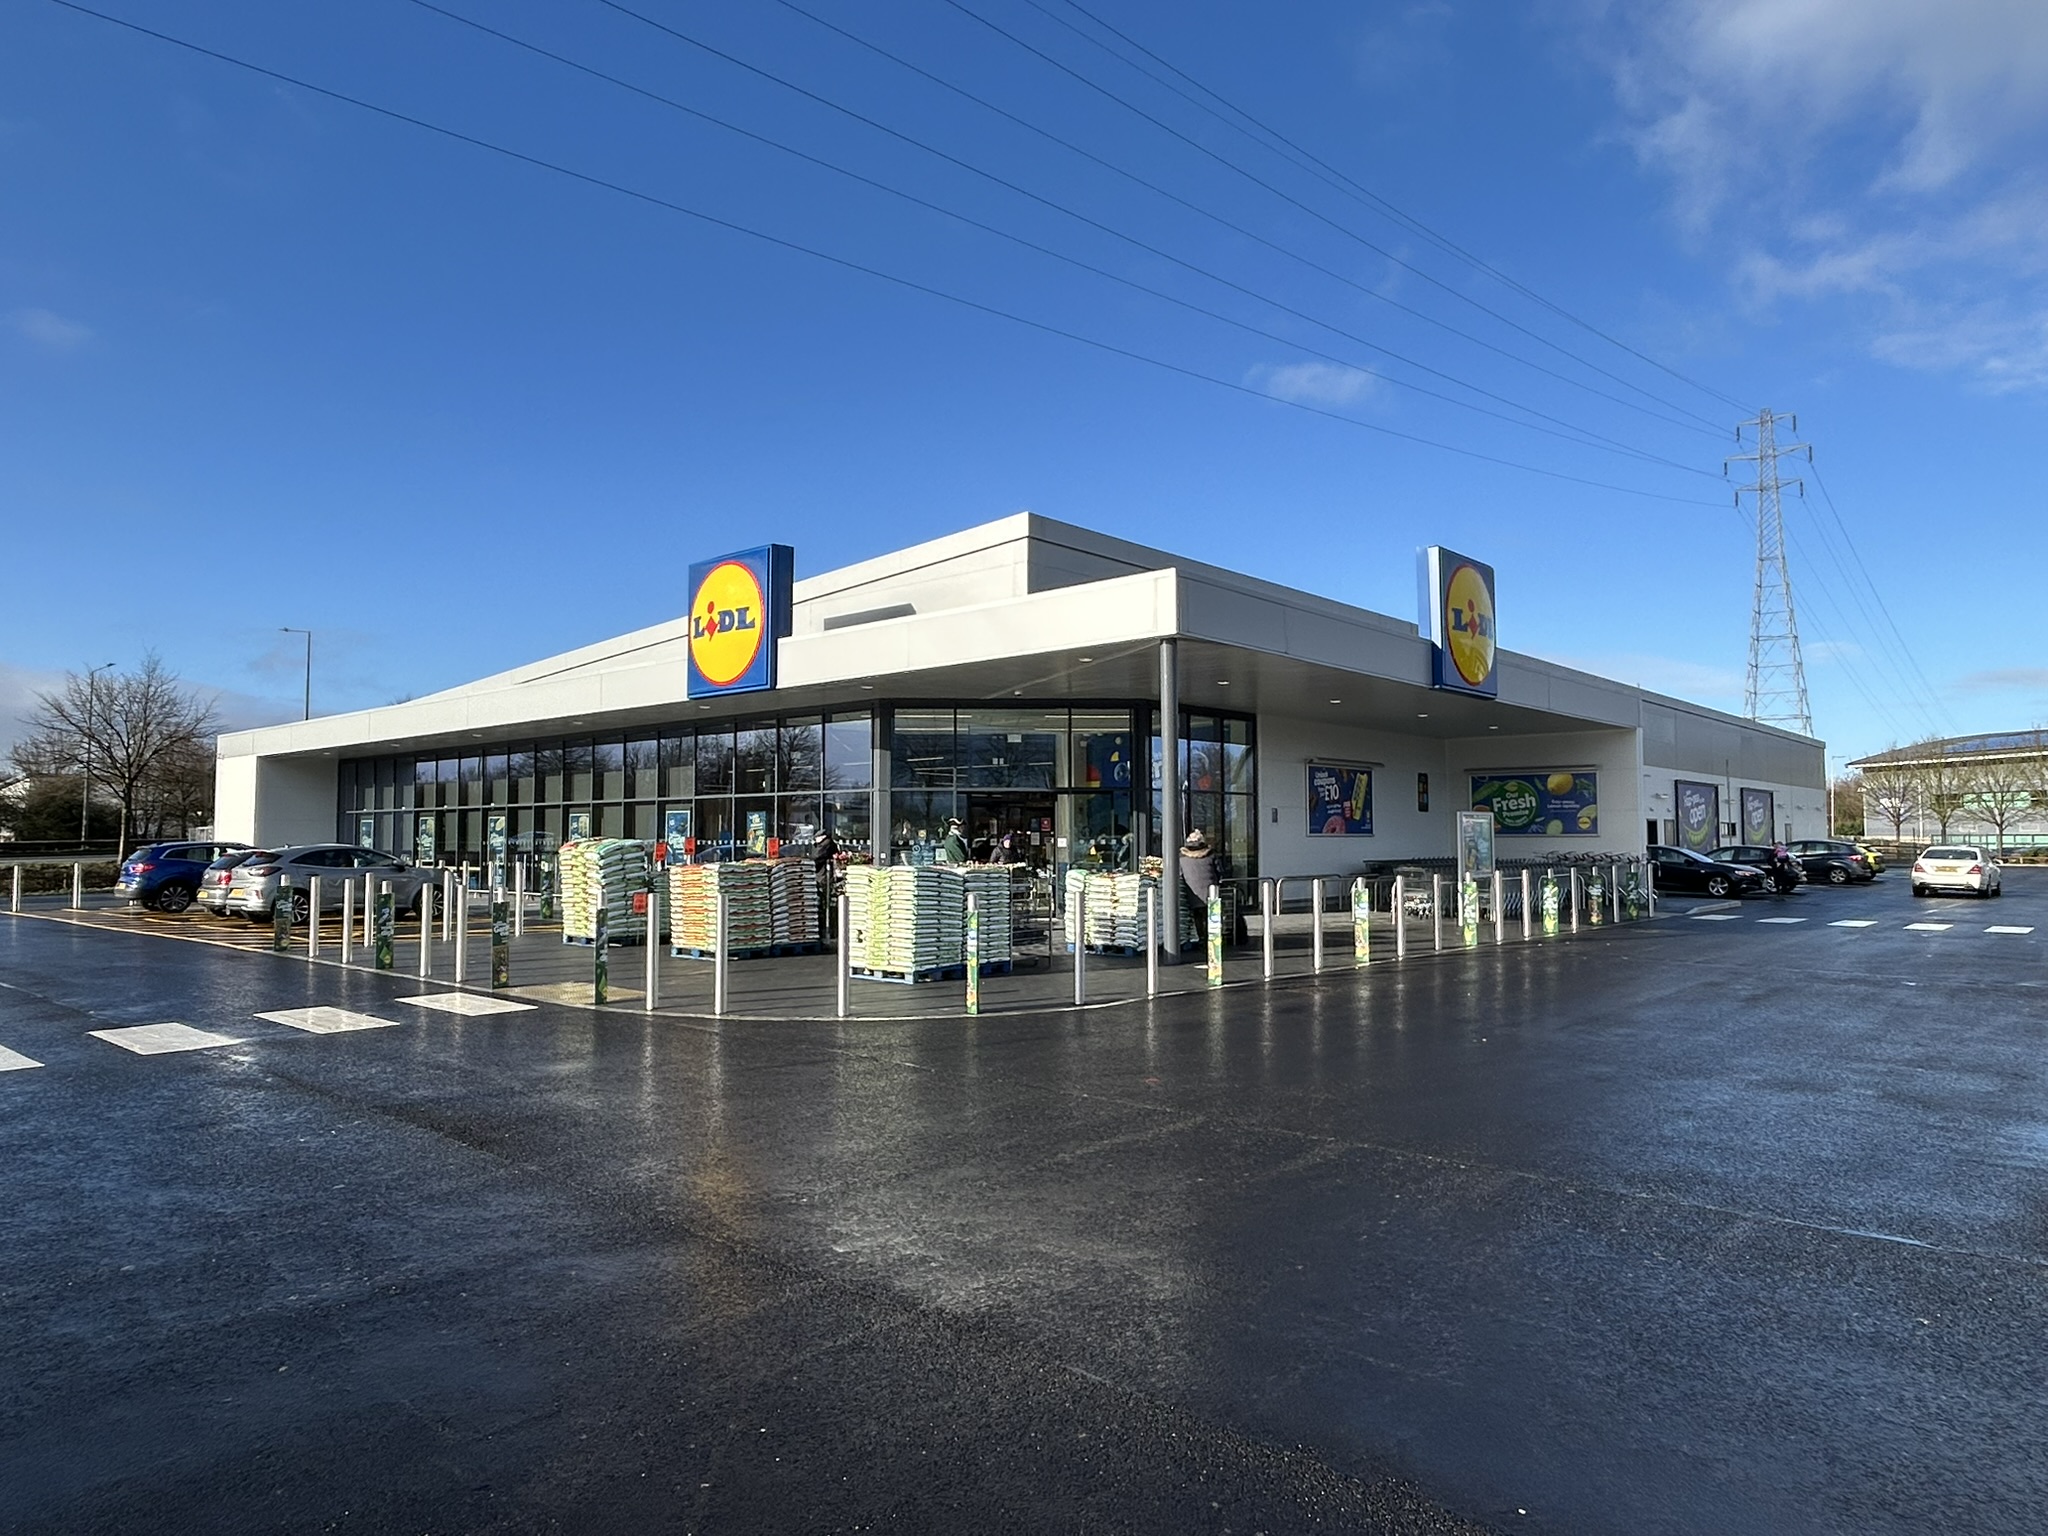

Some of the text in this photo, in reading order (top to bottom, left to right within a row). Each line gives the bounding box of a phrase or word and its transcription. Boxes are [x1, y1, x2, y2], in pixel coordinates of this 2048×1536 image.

[1325, 784, 1340, 801] £10
[1505, 791, 1519, 799] Our
[1492, 793, 1537, 812] Fresh
